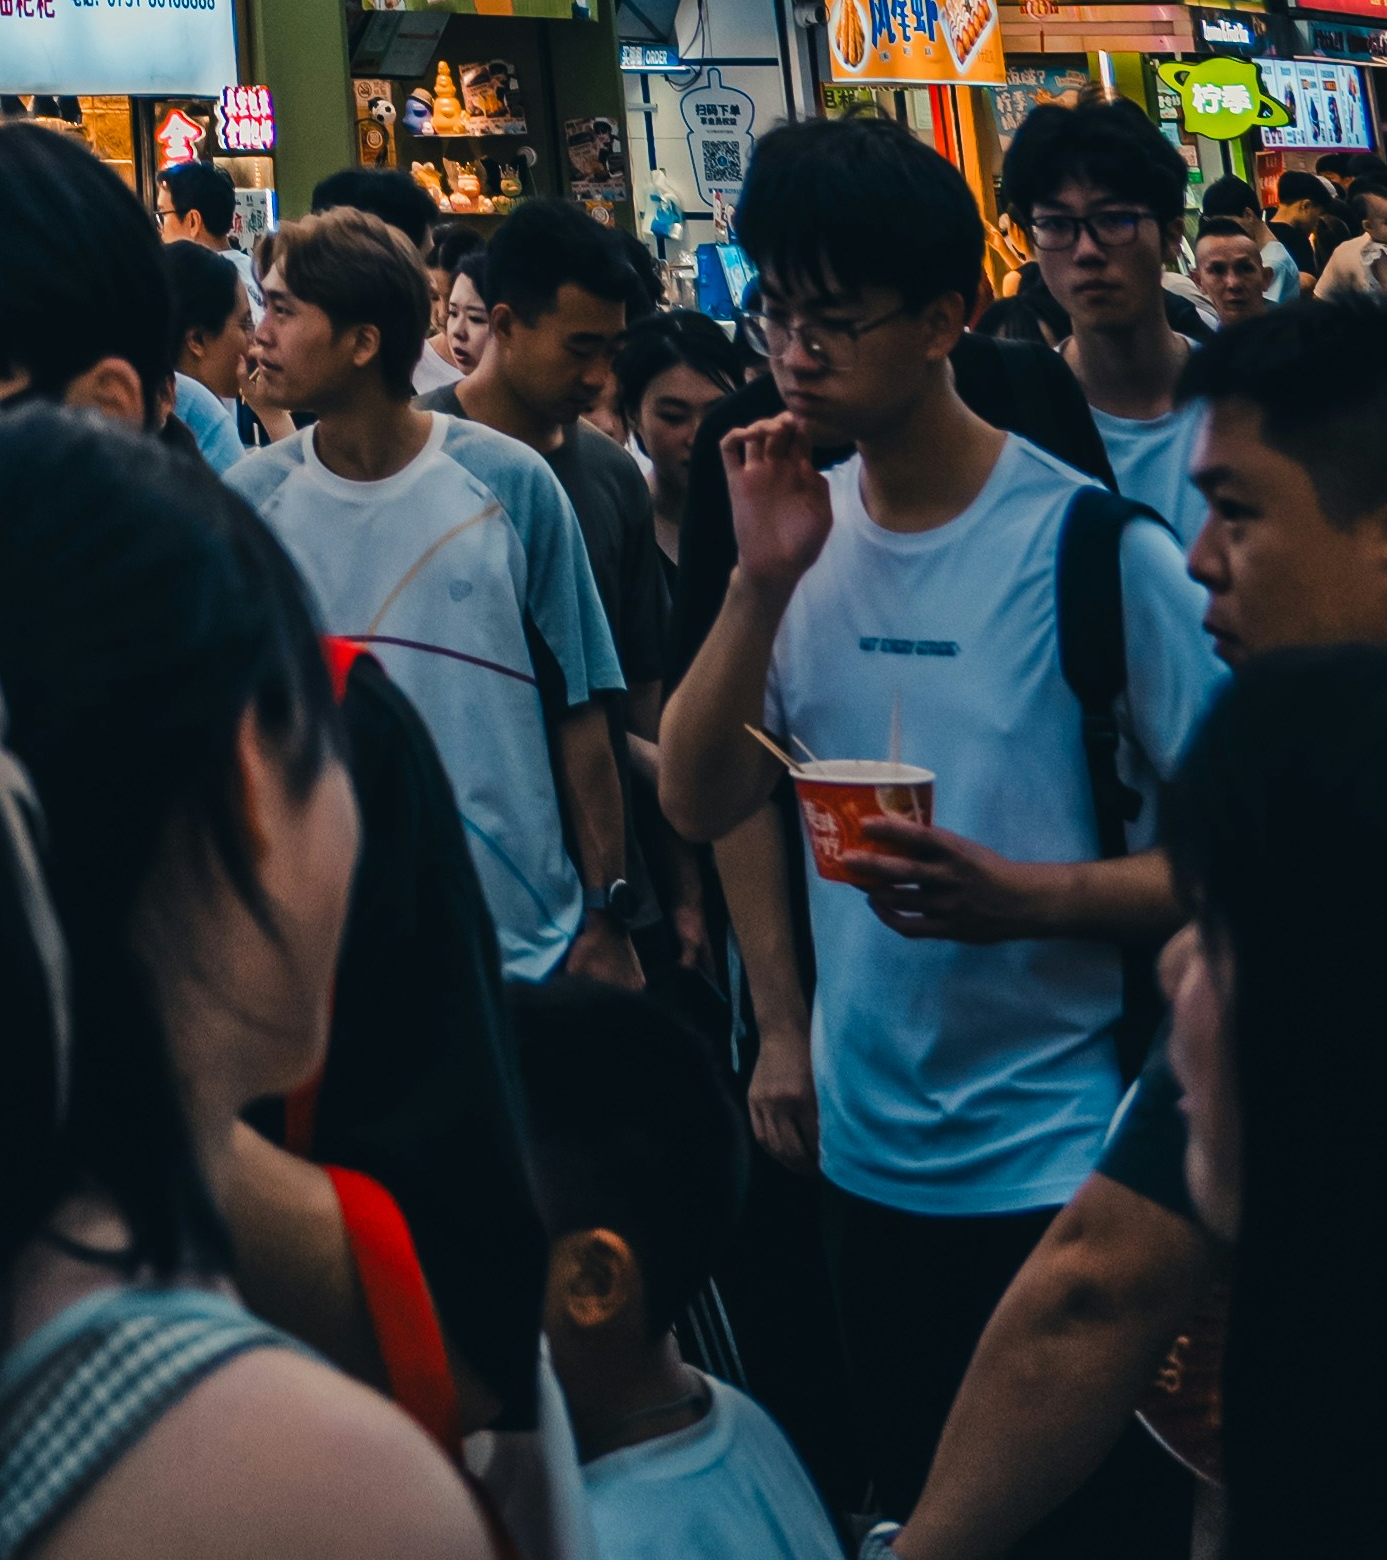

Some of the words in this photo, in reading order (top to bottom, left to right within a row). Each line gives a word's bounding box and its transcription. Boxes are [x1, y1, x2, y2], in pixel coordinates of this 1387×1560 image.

[645, 50, 668, 65] ORDER
[1191, 84, 1252, 113] 柠季
[696, 103, 741, 117] 扫码下单
